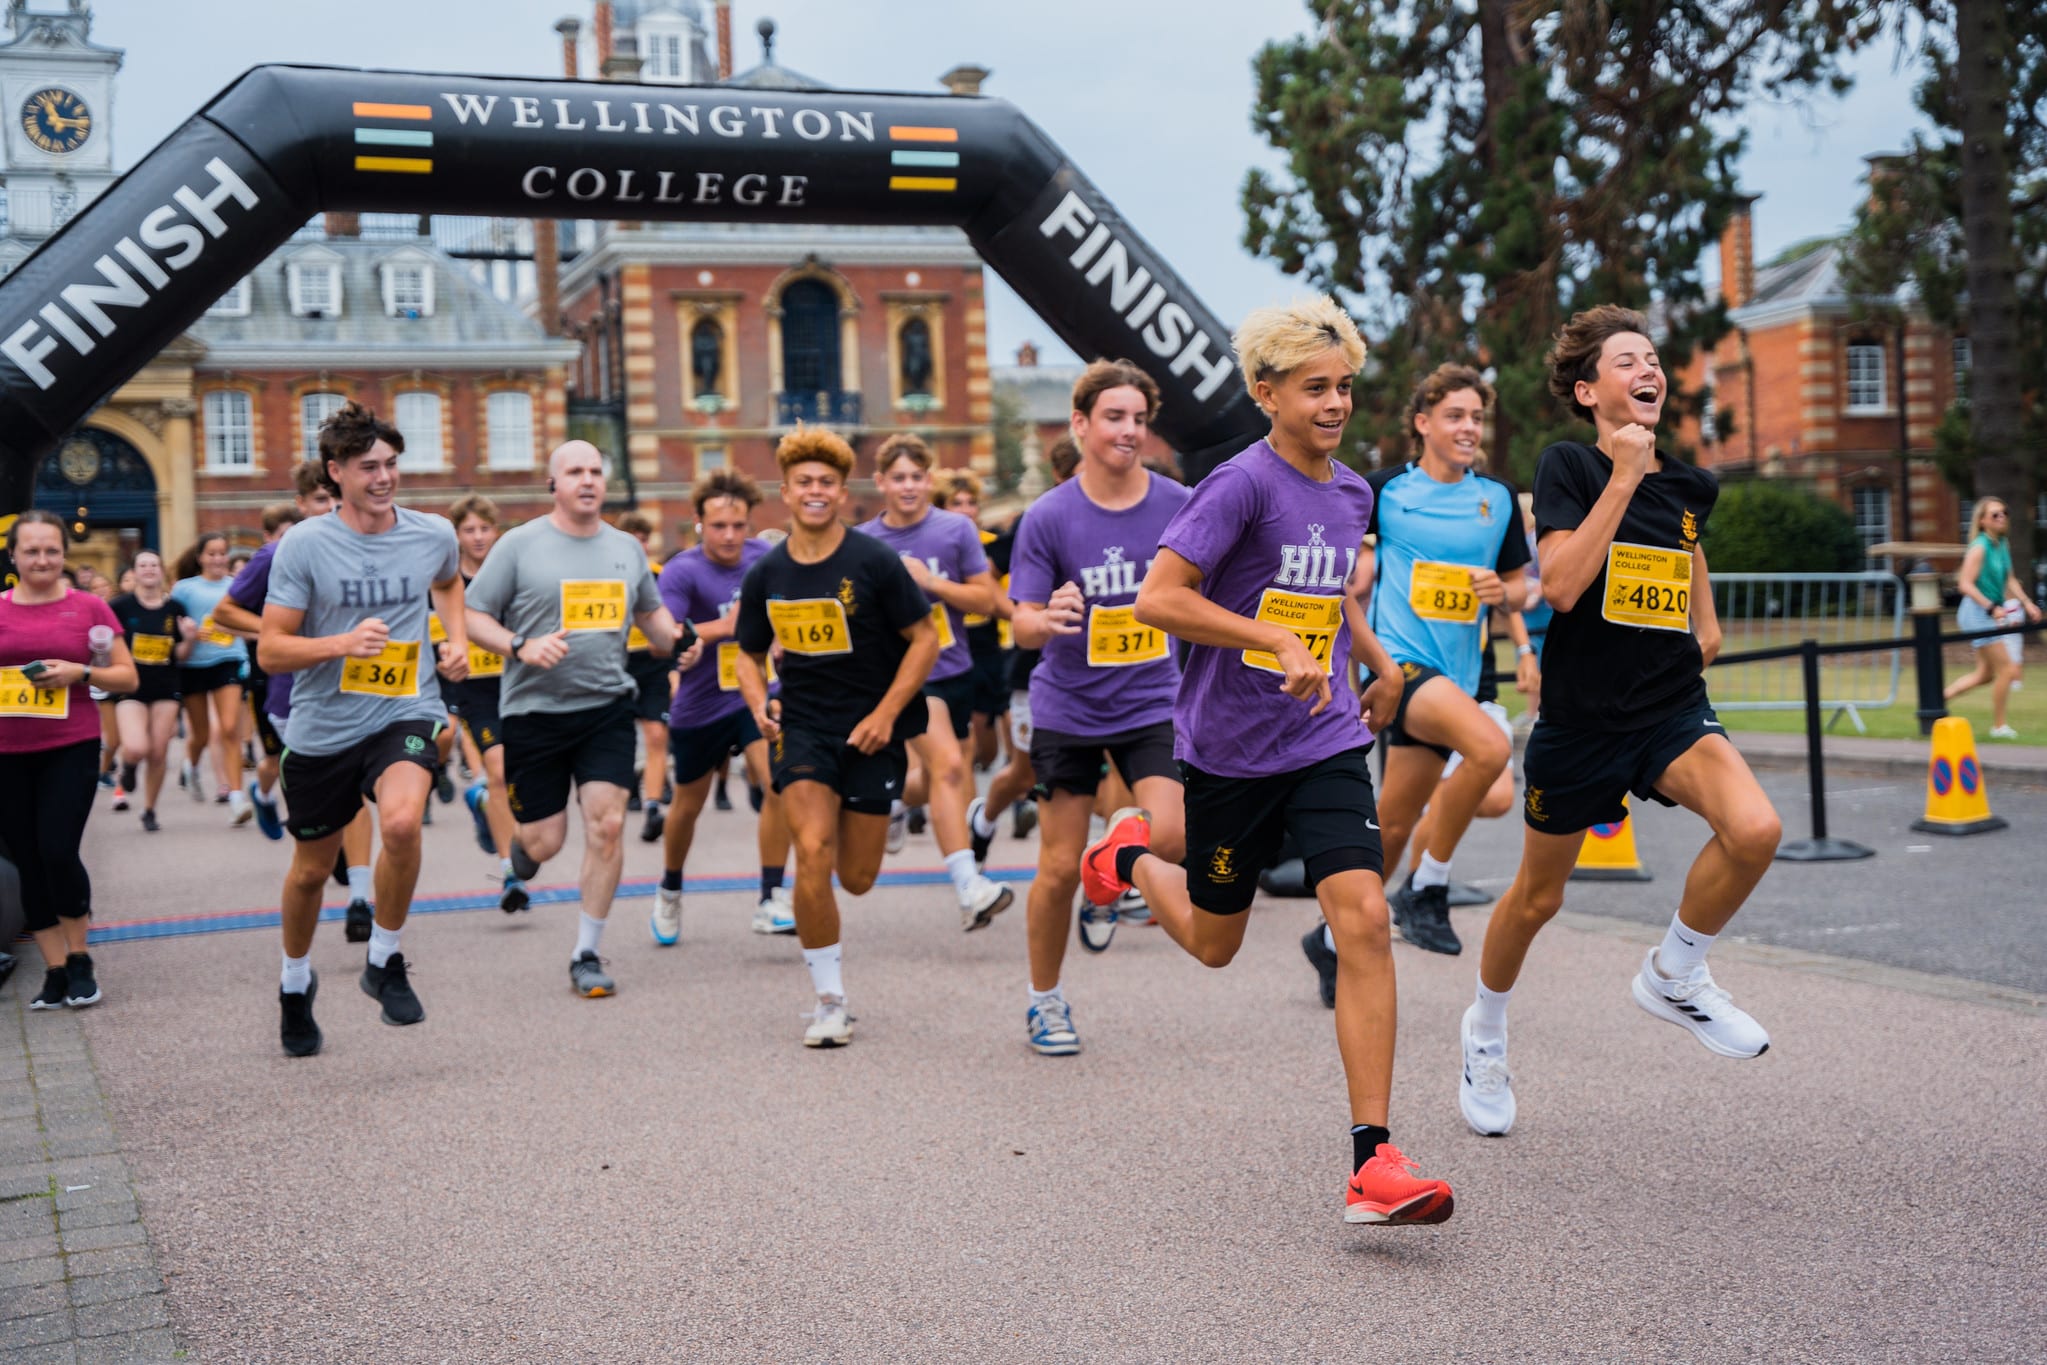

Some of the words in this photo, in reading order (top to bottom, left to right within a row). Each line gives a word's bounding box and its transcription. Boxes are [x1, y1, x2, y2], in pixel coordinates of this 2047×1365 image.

[440, 93, 876, 142] WELLINGTON
[521, 165, 809, 206] COLLEGE
[0, 156, 260, 391] FINISH
[1039, 190, 1234, 401] FINISH
[1615, 561, 1651, 571] COLLEGE
[1616, 550, 1668, 564] WELLINGTON
[1080, 555, 1153, 597] HIL
[339, 576, 420, 608] HILL
[1433, 590, 1472, 611] 833
[1629, 584, 1688, 614] 4820
[584, 602, 618, 620] 473
[1266, 606, 1307, 620] COLLEGE
[1270, 596, 1325, 611] WELLINGTON
[797, 624, 834, 644] 169
[1117, 630, 1154, 653] 371
[1294, 632, 1329, 661] 72
[368, 664, 408, 686] 361
[18, 687, 55, 705] 615
